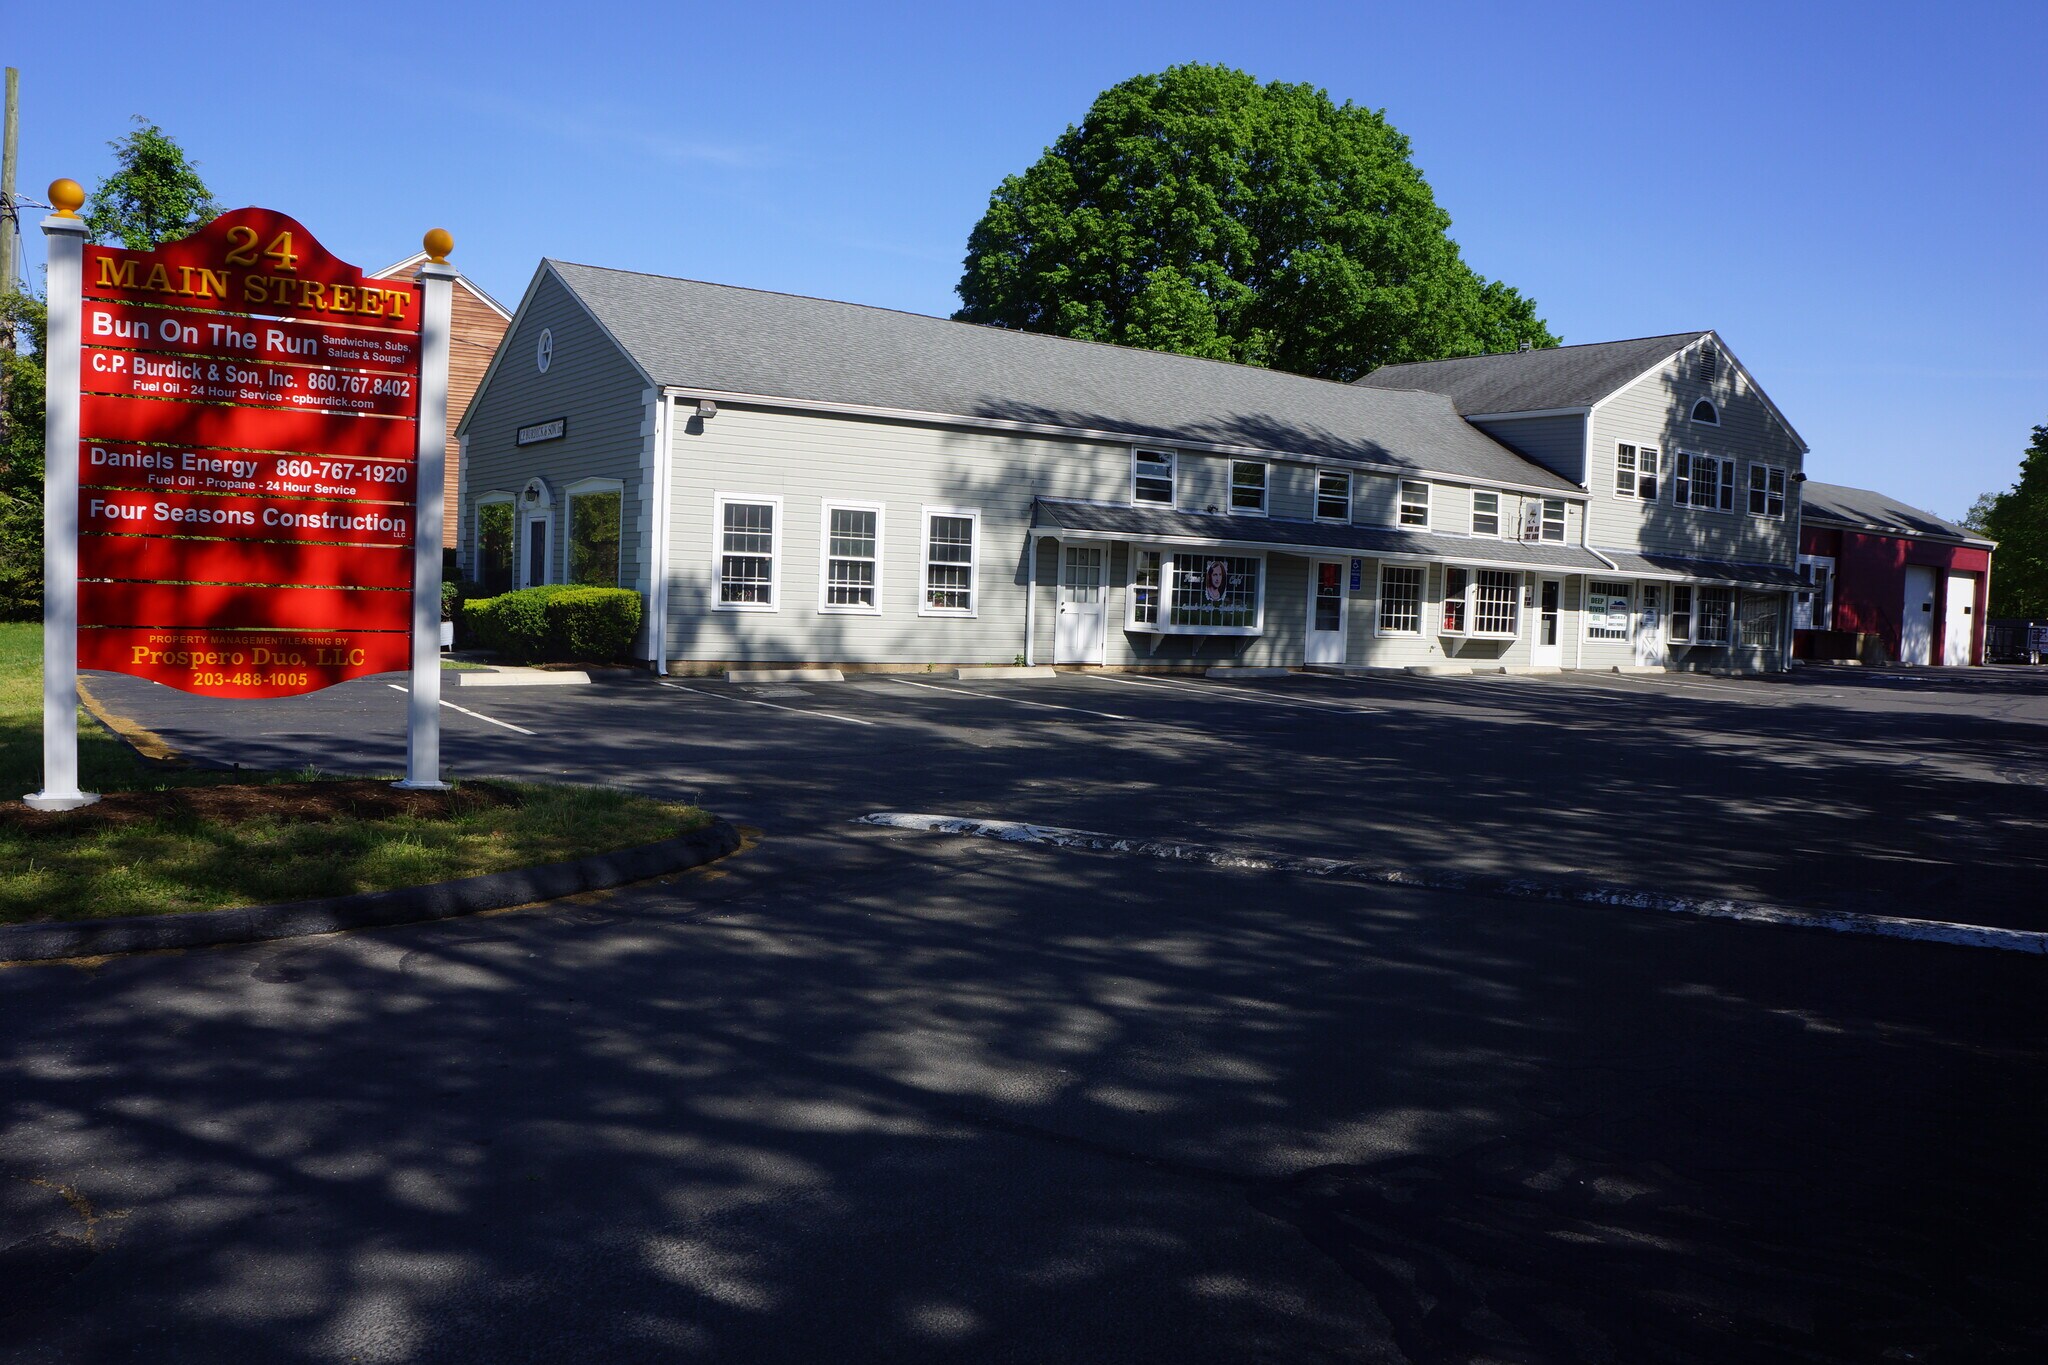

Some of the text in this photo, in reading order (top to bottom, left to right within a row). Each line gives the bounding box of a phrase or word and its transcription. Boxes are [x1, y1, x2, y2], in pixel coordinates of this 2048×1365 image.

[226, 225, 299, 273] 24
[95, 256, 411, 320] MAIN STREET
[92, 311, 317, 355] Bun On The Run
[322, 335, 411, 352] Sandwiches, Subs,
[328, 348, 405, 364] Salads & Soups!
[92, 353, 410, 397] C.P. Burdick & Son, Inc. 860.767.8402
[133, 380, 159, 391] Fuel
[163, 383, 180, 393] Oil
[191, 385, 204, 395] 24
[208, 387, 236, 398] Hour
[240, 388, 283, 401] Service
[293, 394, 374, 409] cpburdick.com
[91, 447, 407, 483] Daniels Energy 860-767-1920
[148, 474, 174, 485] Fuel
[178, 476, 195, 486] Oil
[206, 477, 255, 490] Propane
[266, 481, 280, 491] 24
[283, 482, 311, 493] Hour
[315, 483, 356, 494] Service
[90, 499, 406, 531] Four Seasons Construction
[150, 635, 348, 646] PROPERTY MANAGEMENT/LEASING BY
[131, 646, 365, 669] Prospero Duo, LLC
[193, 672, 308, 686] 203-488-1005
